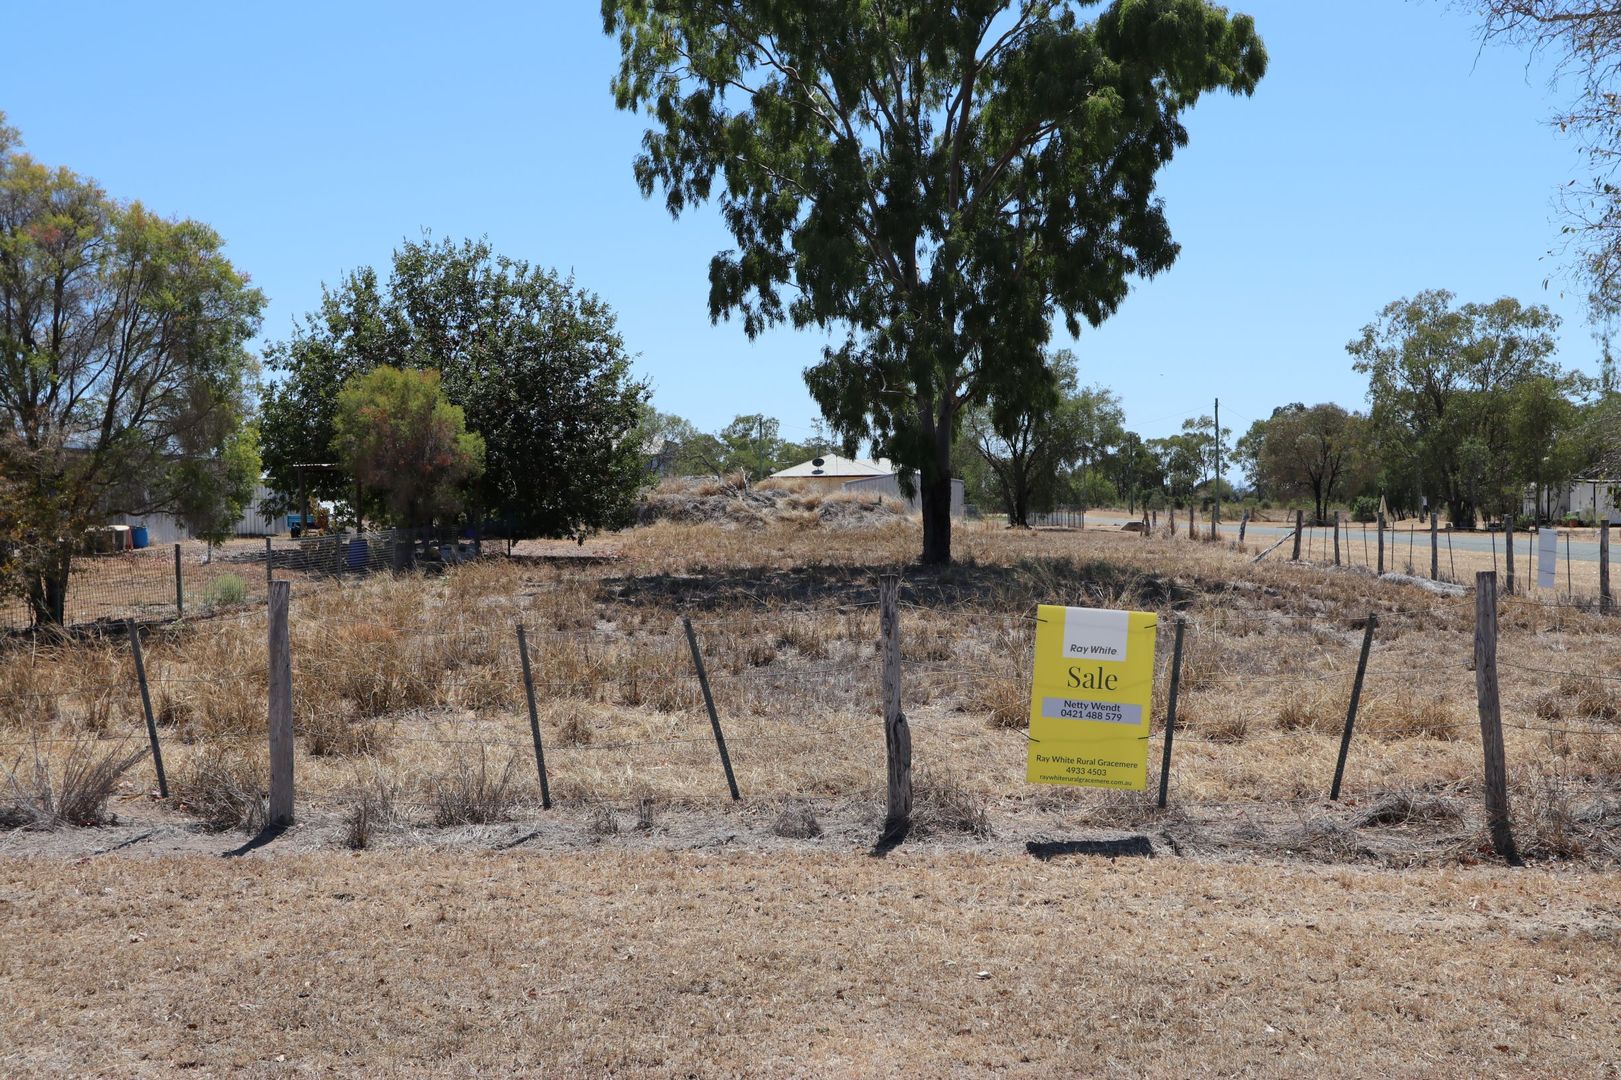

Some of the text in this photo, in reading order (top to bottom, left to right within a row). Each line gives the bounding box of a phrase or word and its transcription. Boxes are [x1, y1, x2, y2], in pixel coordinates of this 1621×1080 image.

[1070, 644, 1117, 655] Ray White
[1067, 666, 1118, 690] Sale
[1064, 700, 1120, 712] Netty Wendt
[1060, 709, 1122, 721] 0421 488 579
[1036, 754, 1138, 769] Ray White Rural Gracemere
[1066, 766, 1107, 776] 4933 4503
[1039, 774, 1133, 786] raywhiteruralgracemere.com.au
